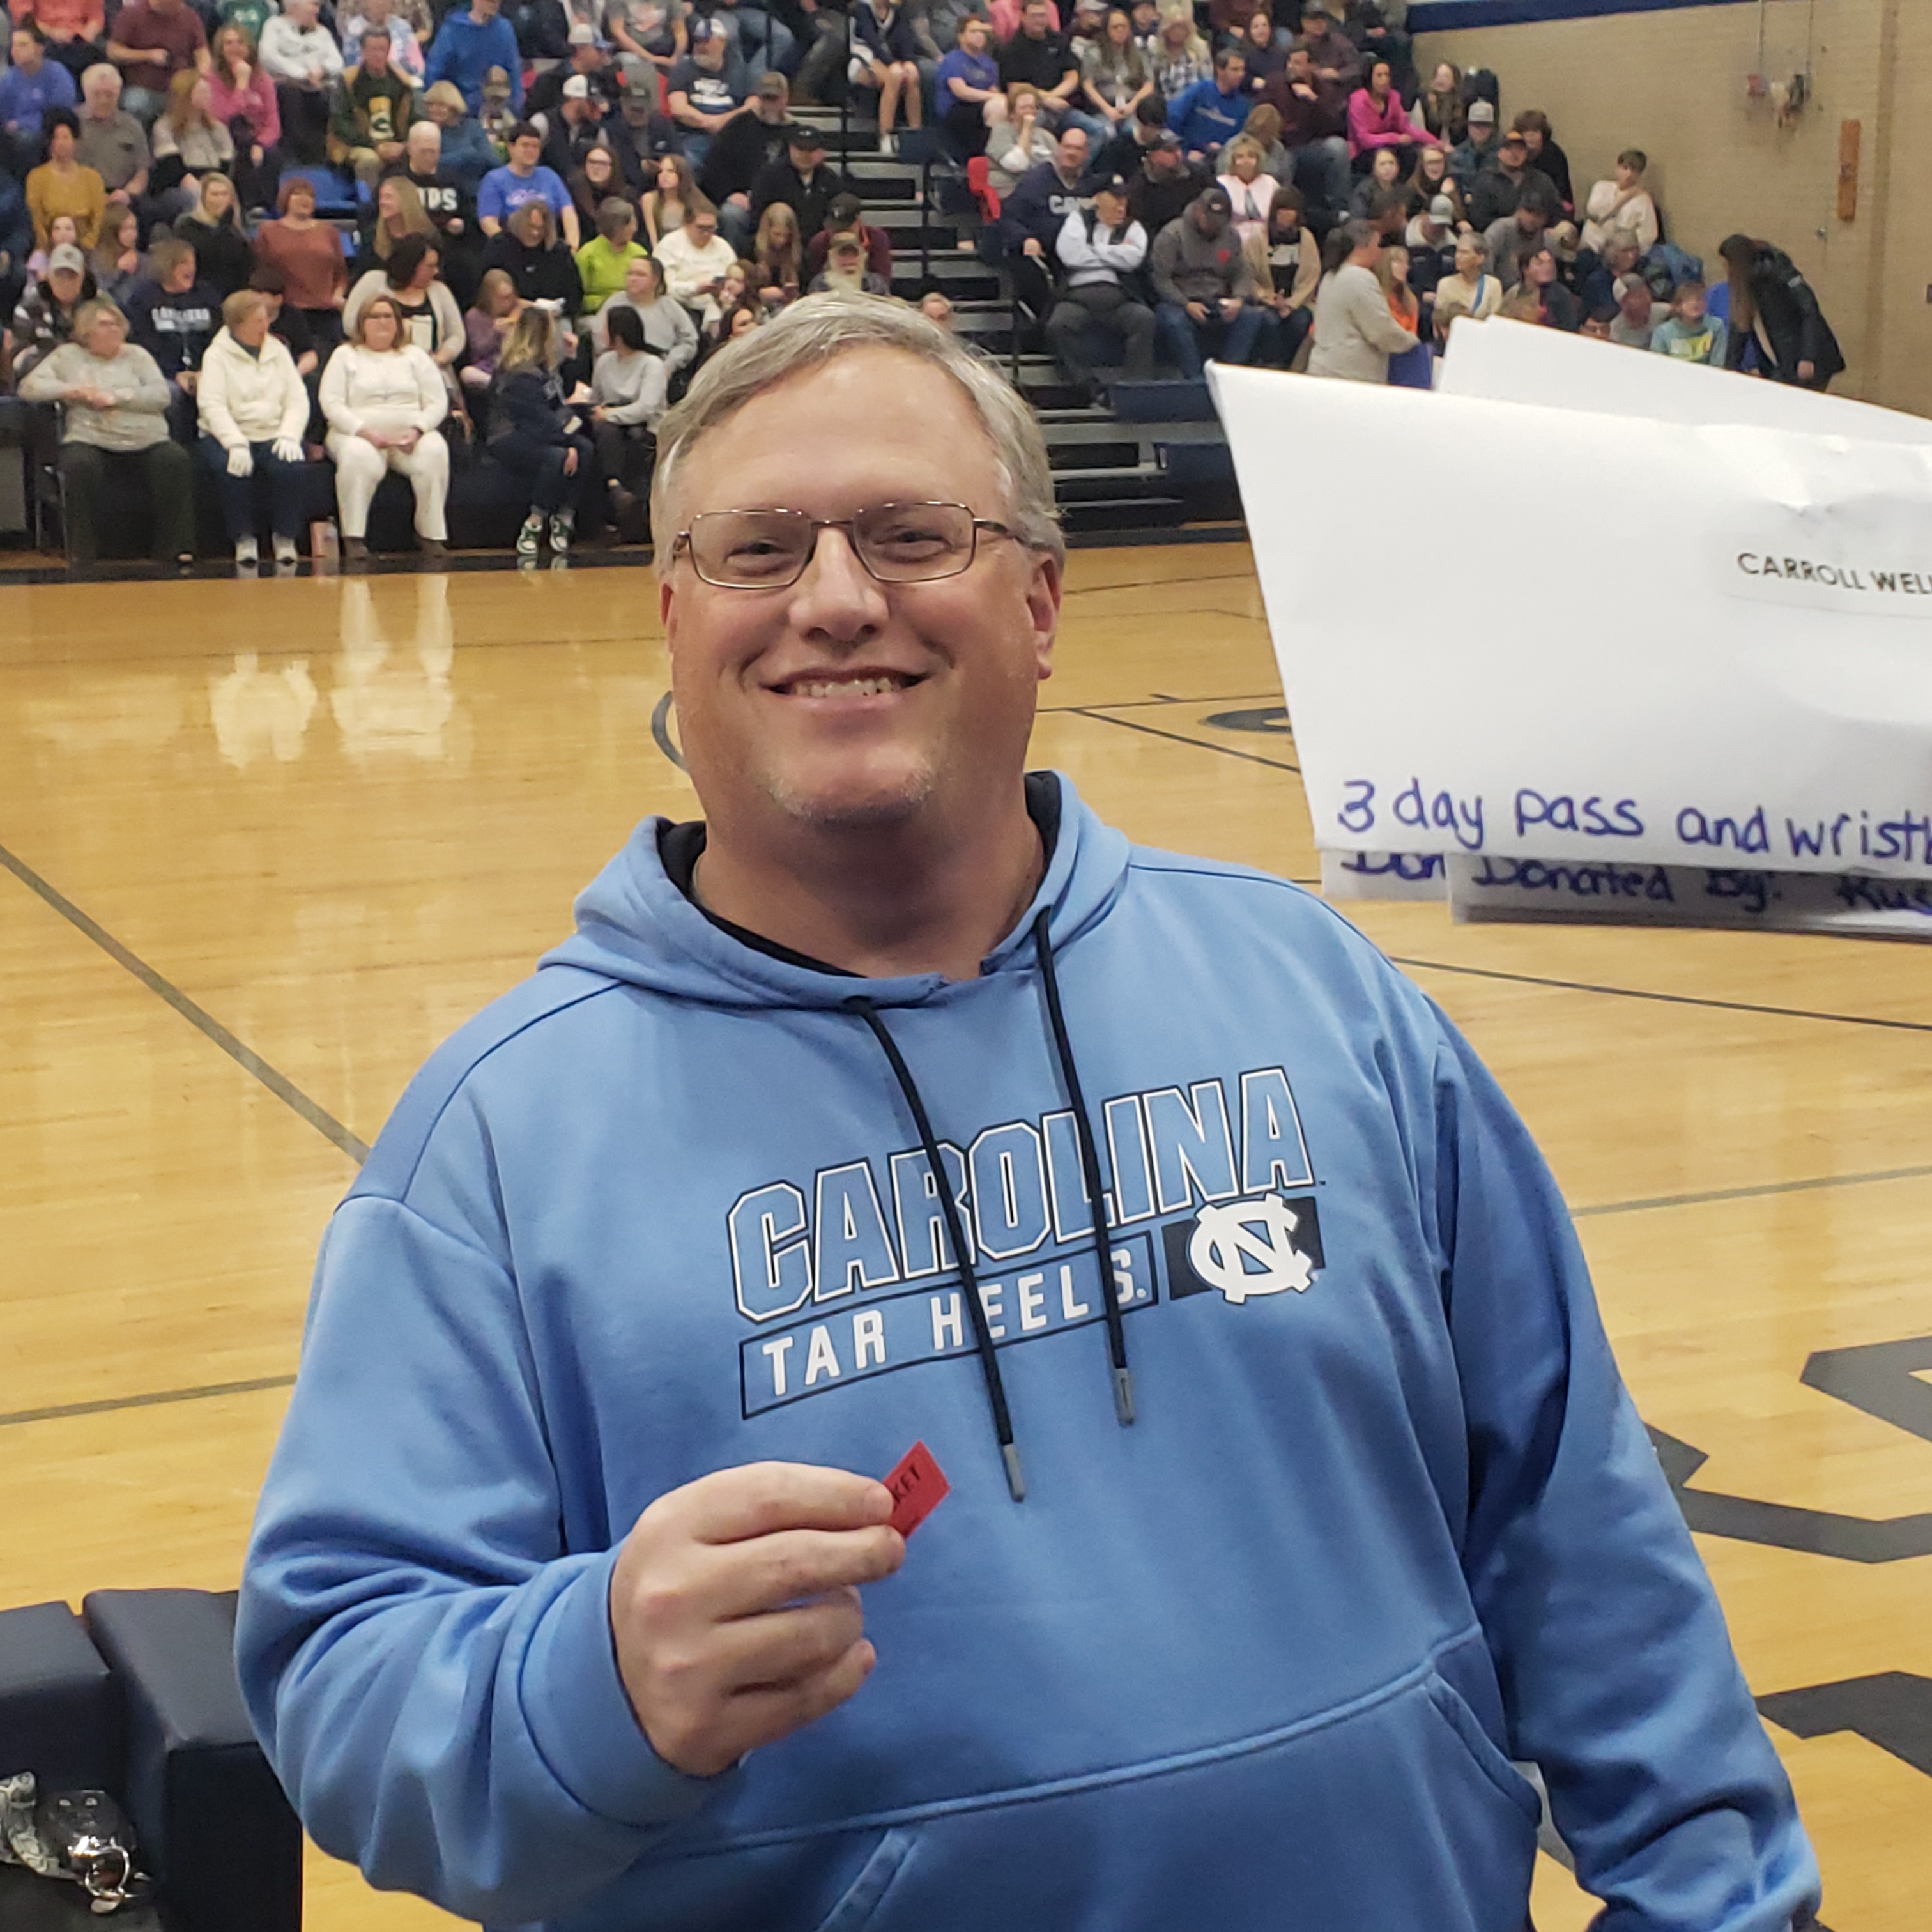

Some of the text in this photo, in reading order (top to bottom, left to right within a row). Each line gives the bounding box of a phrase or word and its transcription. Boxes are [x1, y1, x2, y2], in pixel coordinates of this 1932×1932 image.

[1737, 552, 1867, 590] CARROLL
[1338, 779, 1375, 833] 3
[1393, 776, 1483, 850] day
[1515, 788, 1644, 837] pass
[1676, 806, 1770, 854] and
[726, 1066, 1315, 1322] CAROLINA
[763, 1310, 886, 1396] TAR
[891, 1463, 921, 1504] KET
